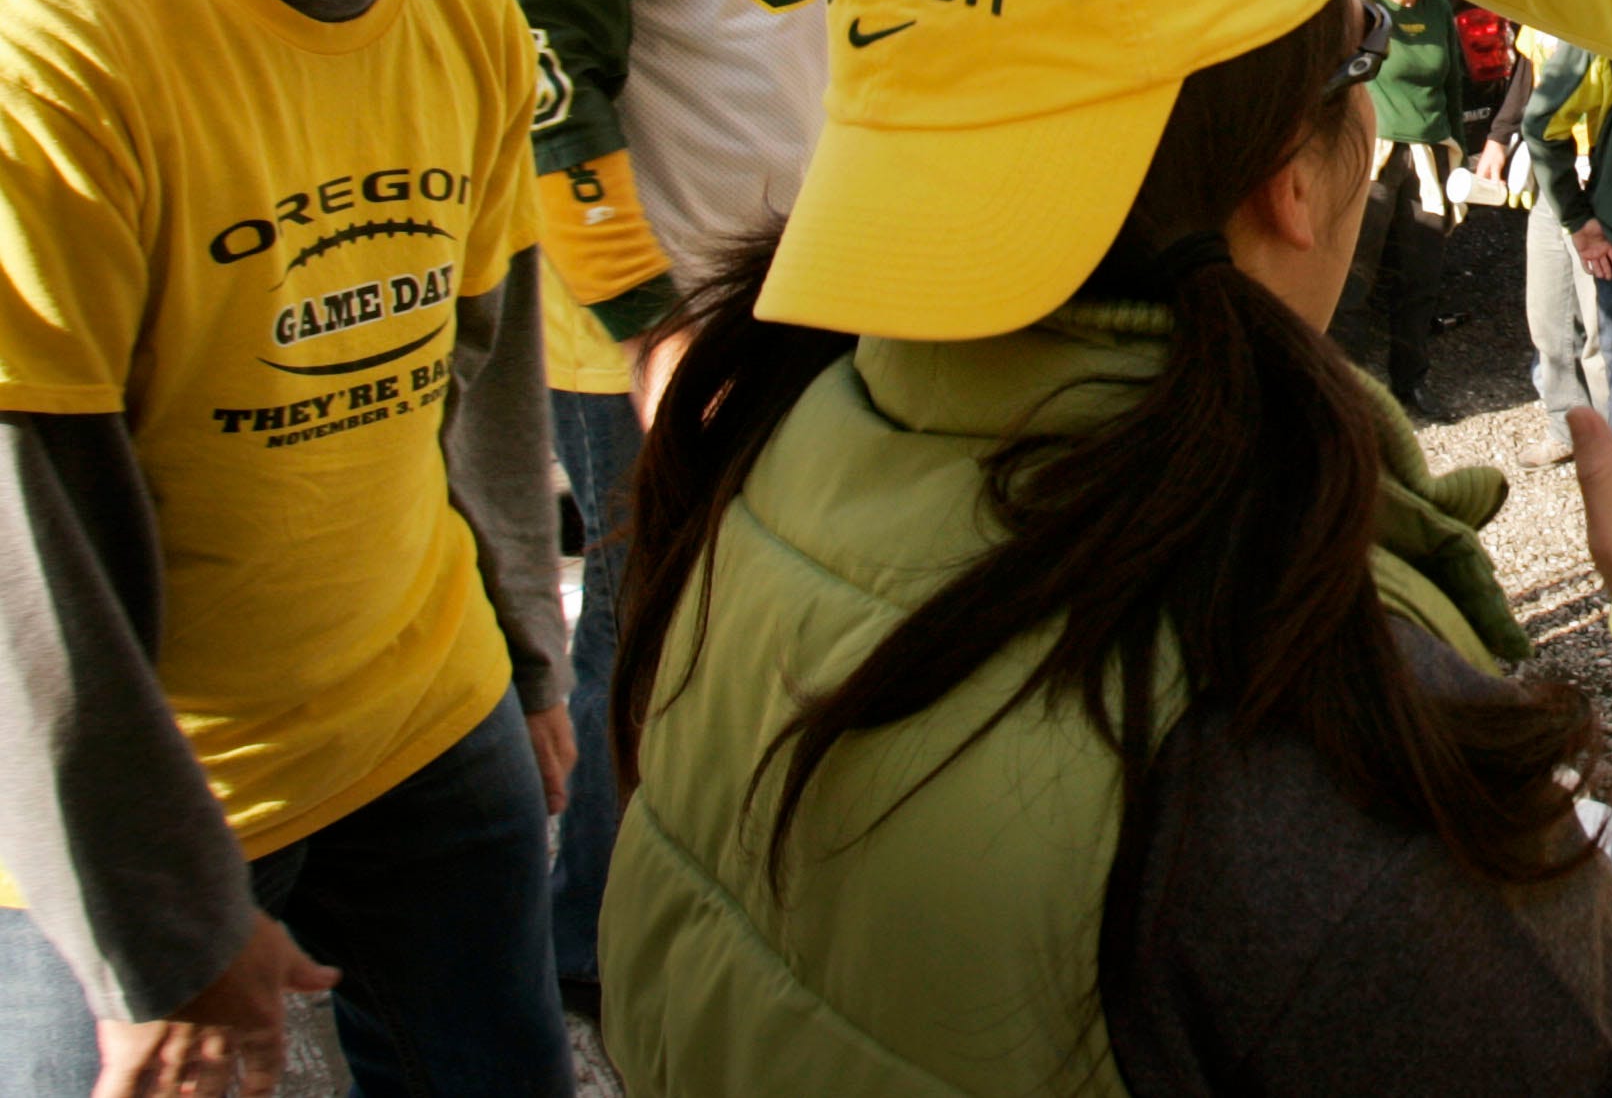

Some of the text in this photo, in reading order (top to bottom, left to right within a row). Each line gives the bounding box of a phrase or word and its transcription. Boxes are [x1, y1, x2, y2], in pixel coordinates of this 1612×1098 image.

[274, 282, 382, 348] GAME
[213, 375, 400, 433] THEY'RE
[266, 405, 389, 448] NOVEMBER
